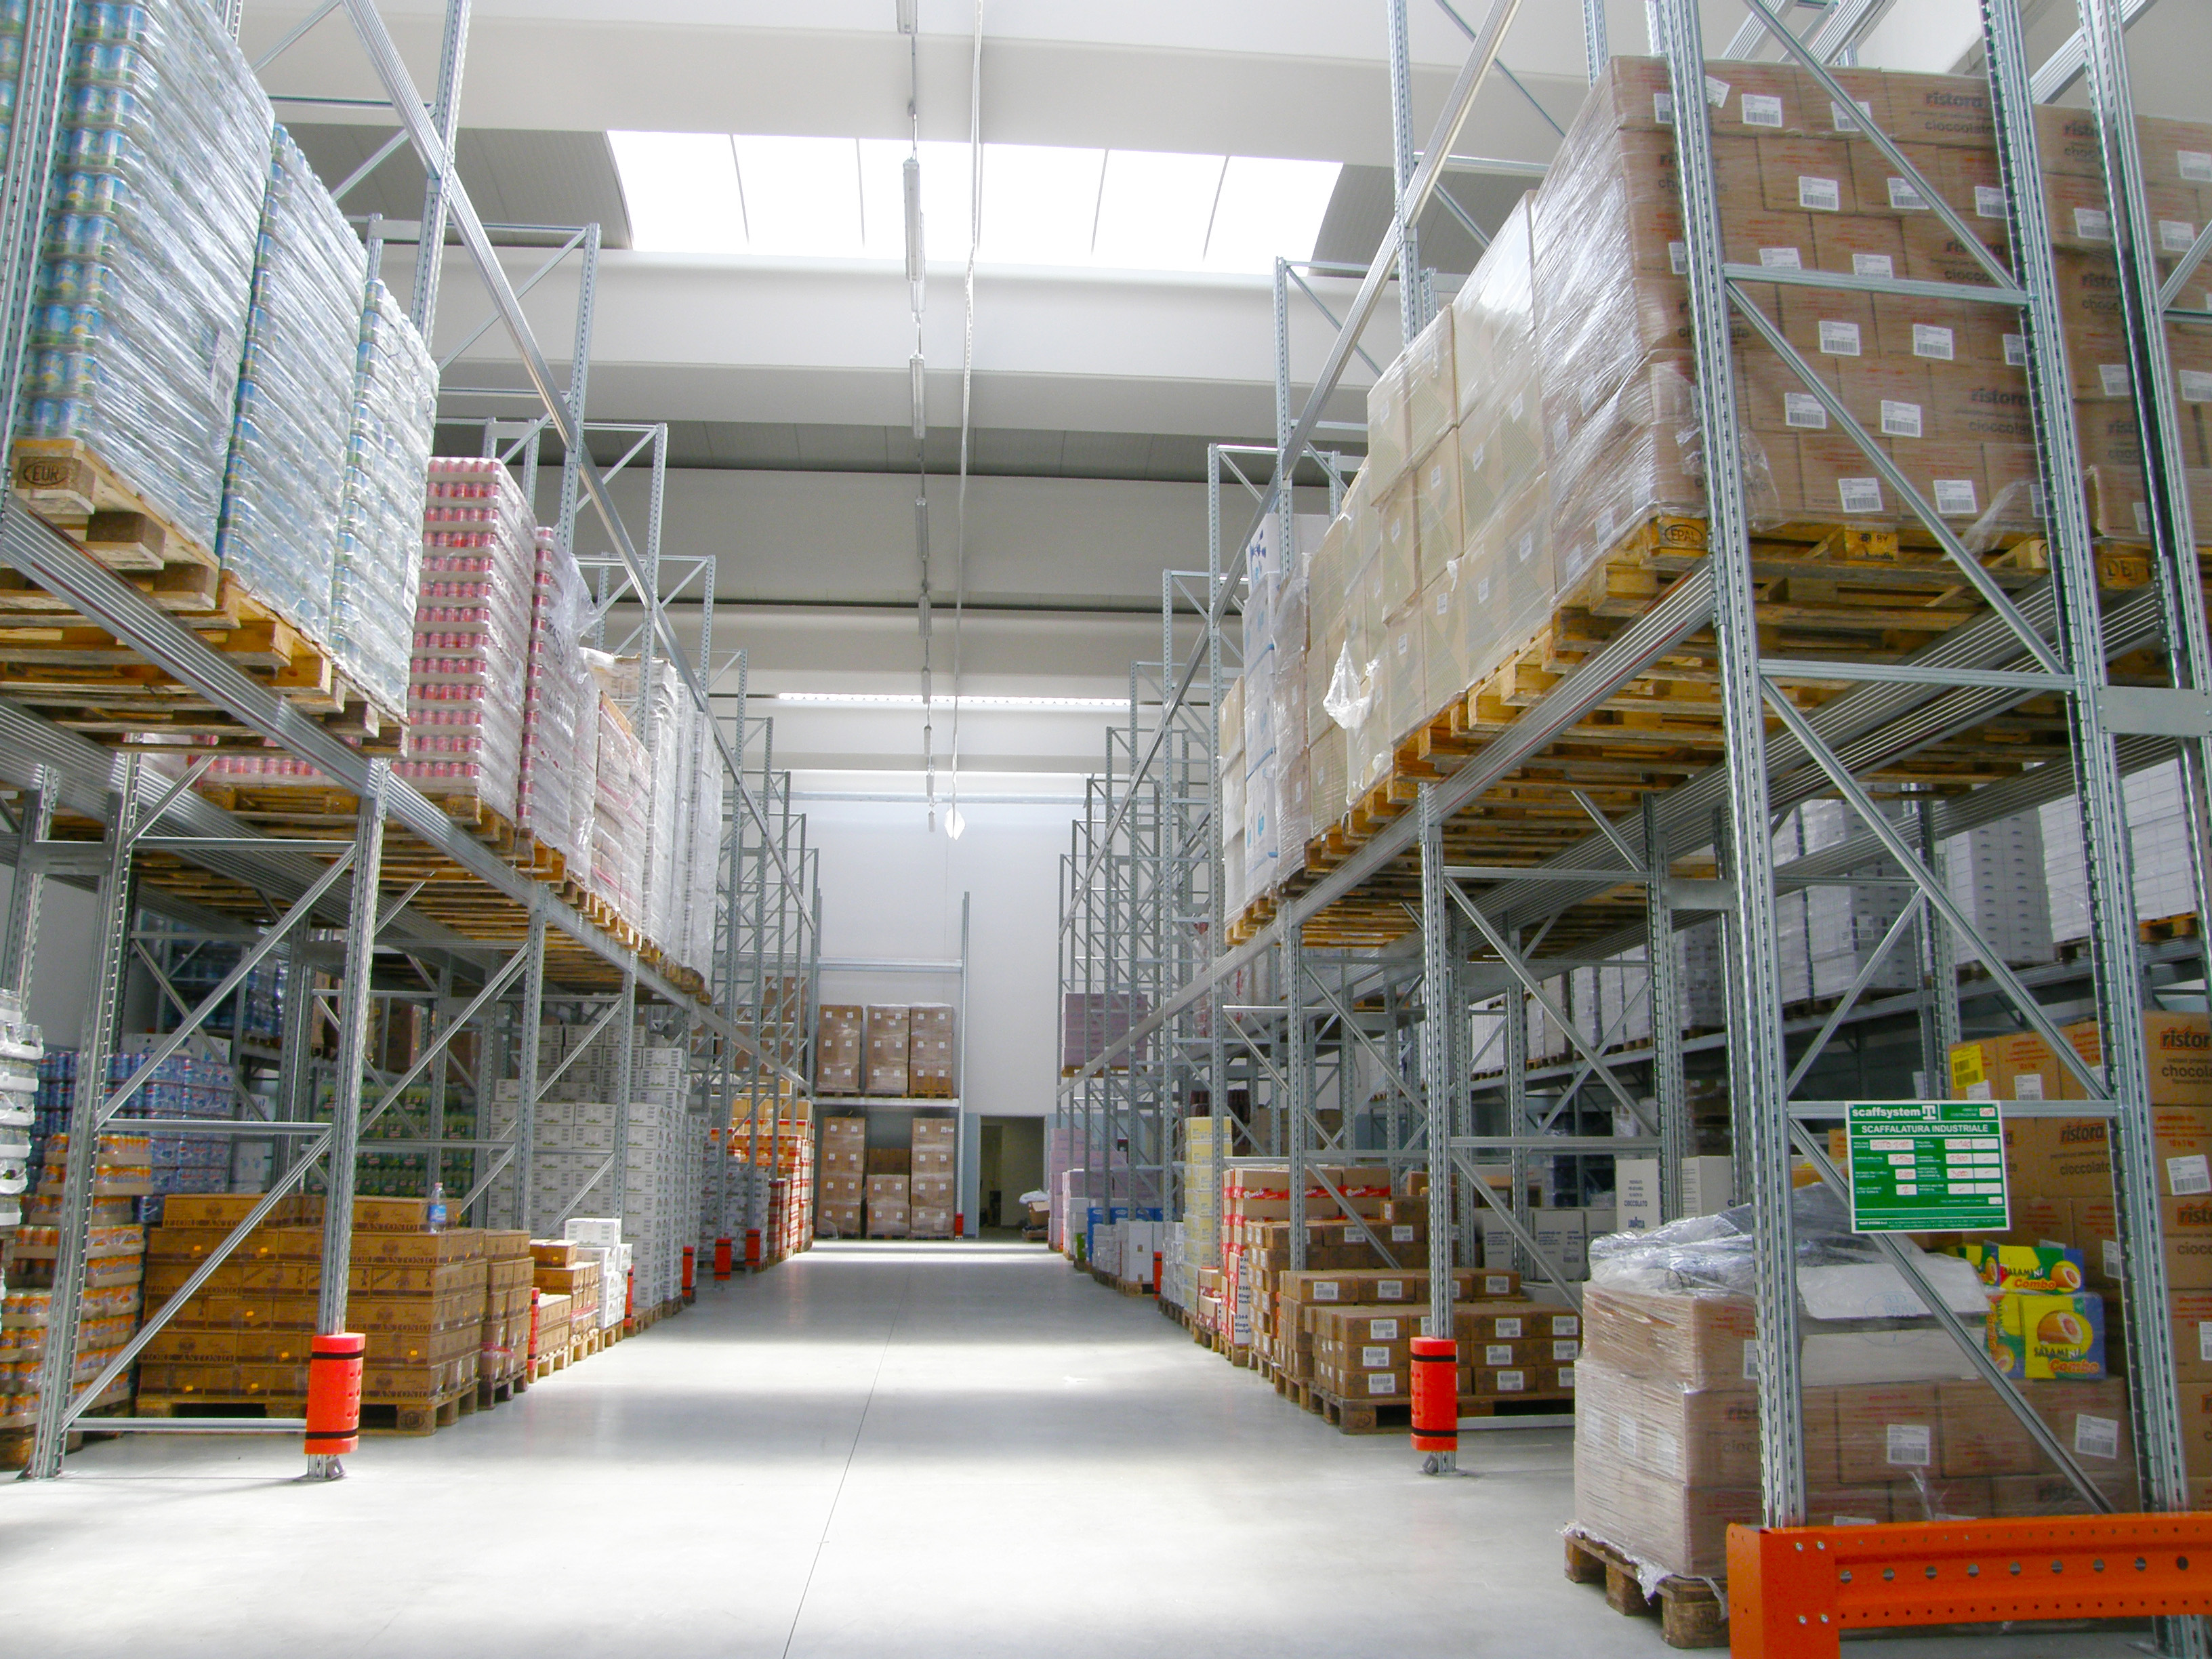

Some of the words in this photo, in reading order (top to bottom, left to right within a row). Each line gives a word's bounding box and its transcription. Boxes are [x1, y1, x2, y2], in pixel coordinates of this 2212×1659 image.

[1925, 91, 1983, 108] ristora
[32, 464, 60, 481] EUR
[2161, 1028, 2211, 1048] ristor
[2161, 1065, 2212, 1077] chocol
[1852, 1107, 1921, 1118] scaffsystem
[1862, 1125, 1930, 1133] SCAFFALATURA
[1932, 1124, 1988, 1132] INDUSTRIALE
[2060, 1123, 2105, 1143] ristora
[2179, 1206, 2212, 1223] rist
[2014, 1277, 2057, 1290] Combo
[2034, 1347, 2081, 1358] SALAMINI
[2050, 1358, 2100, 1374] Combo
